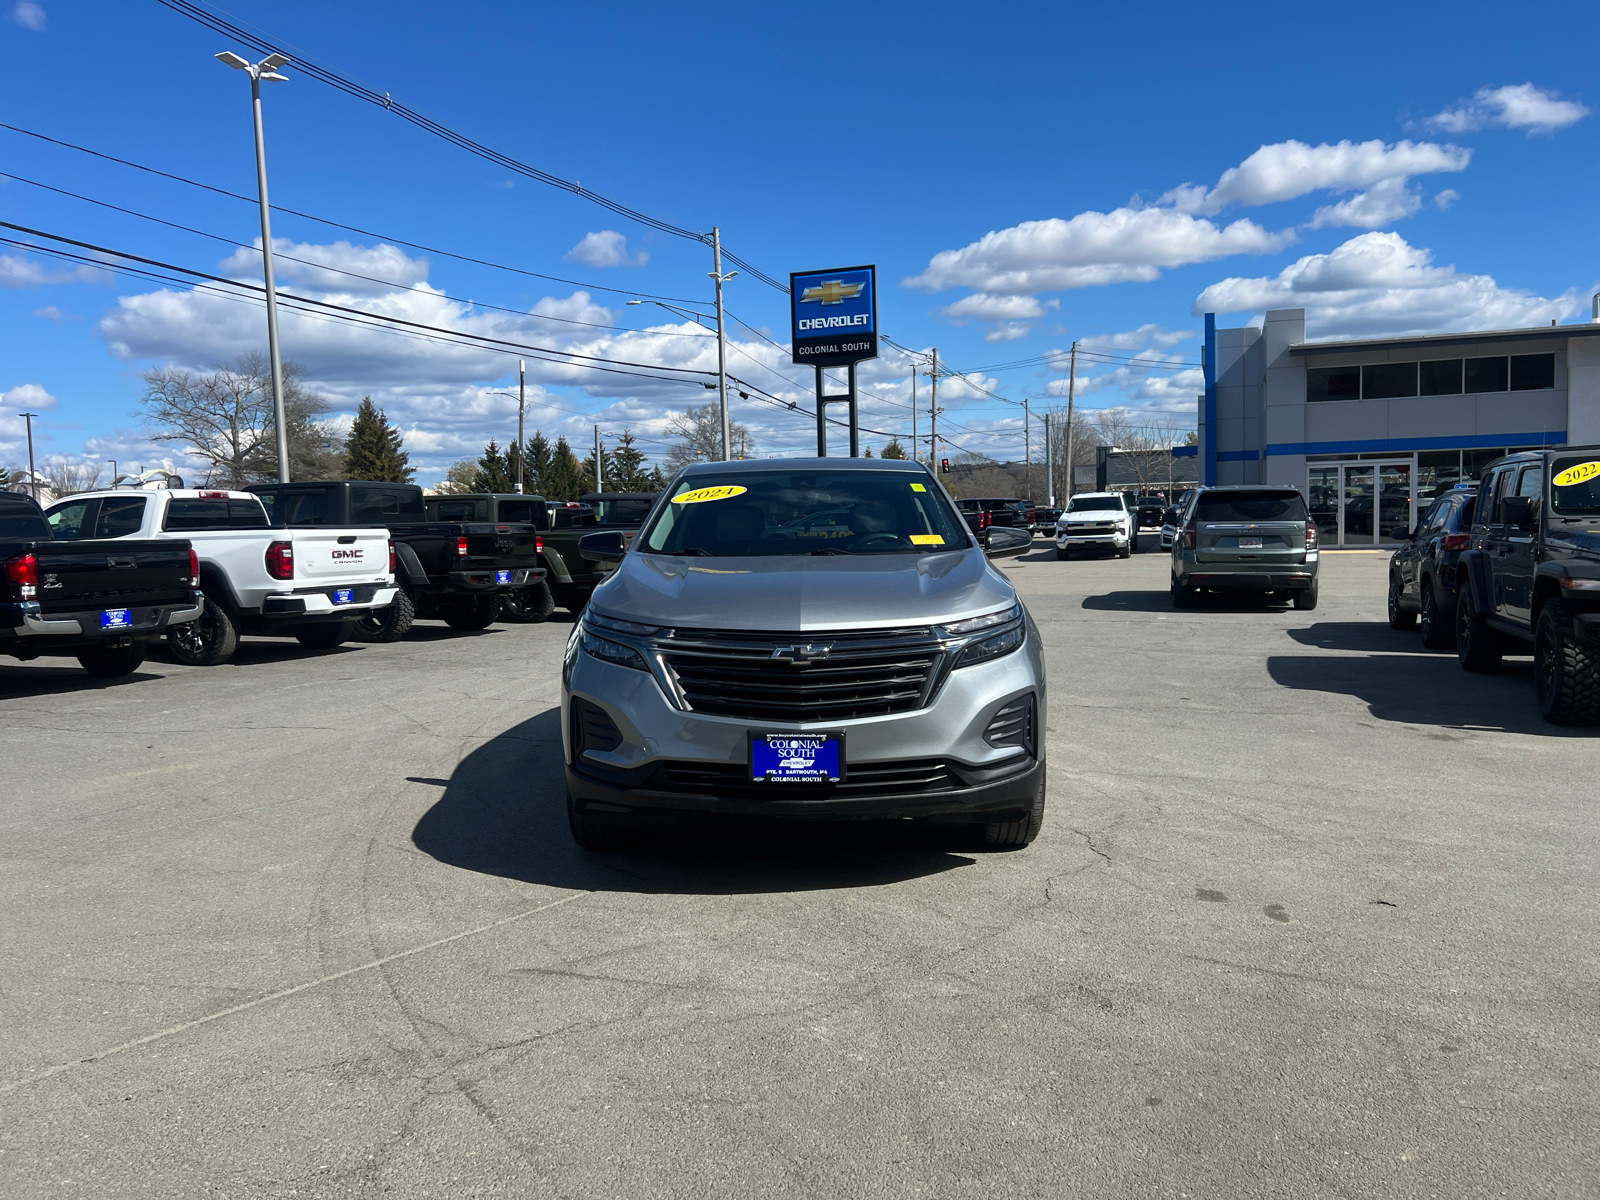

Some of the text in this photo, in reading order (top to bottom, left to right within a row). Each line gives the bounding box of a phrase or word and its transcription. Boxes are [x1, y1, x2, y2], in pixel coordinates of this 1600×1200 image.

[799, 314, 869, 330] CHEVROLET
[799, 342, 870, 355] COLONIAL SOUTH
[1564, 463, 1598, 484] 2022
[684, 487, 735, 502] 2024
[494, 537, 513, 549] Jeep
[331, 549, 364, 559] GMC
[770, 740, 824, 749] COLONIAL
[778, 749, 815, 758] SOUTH
